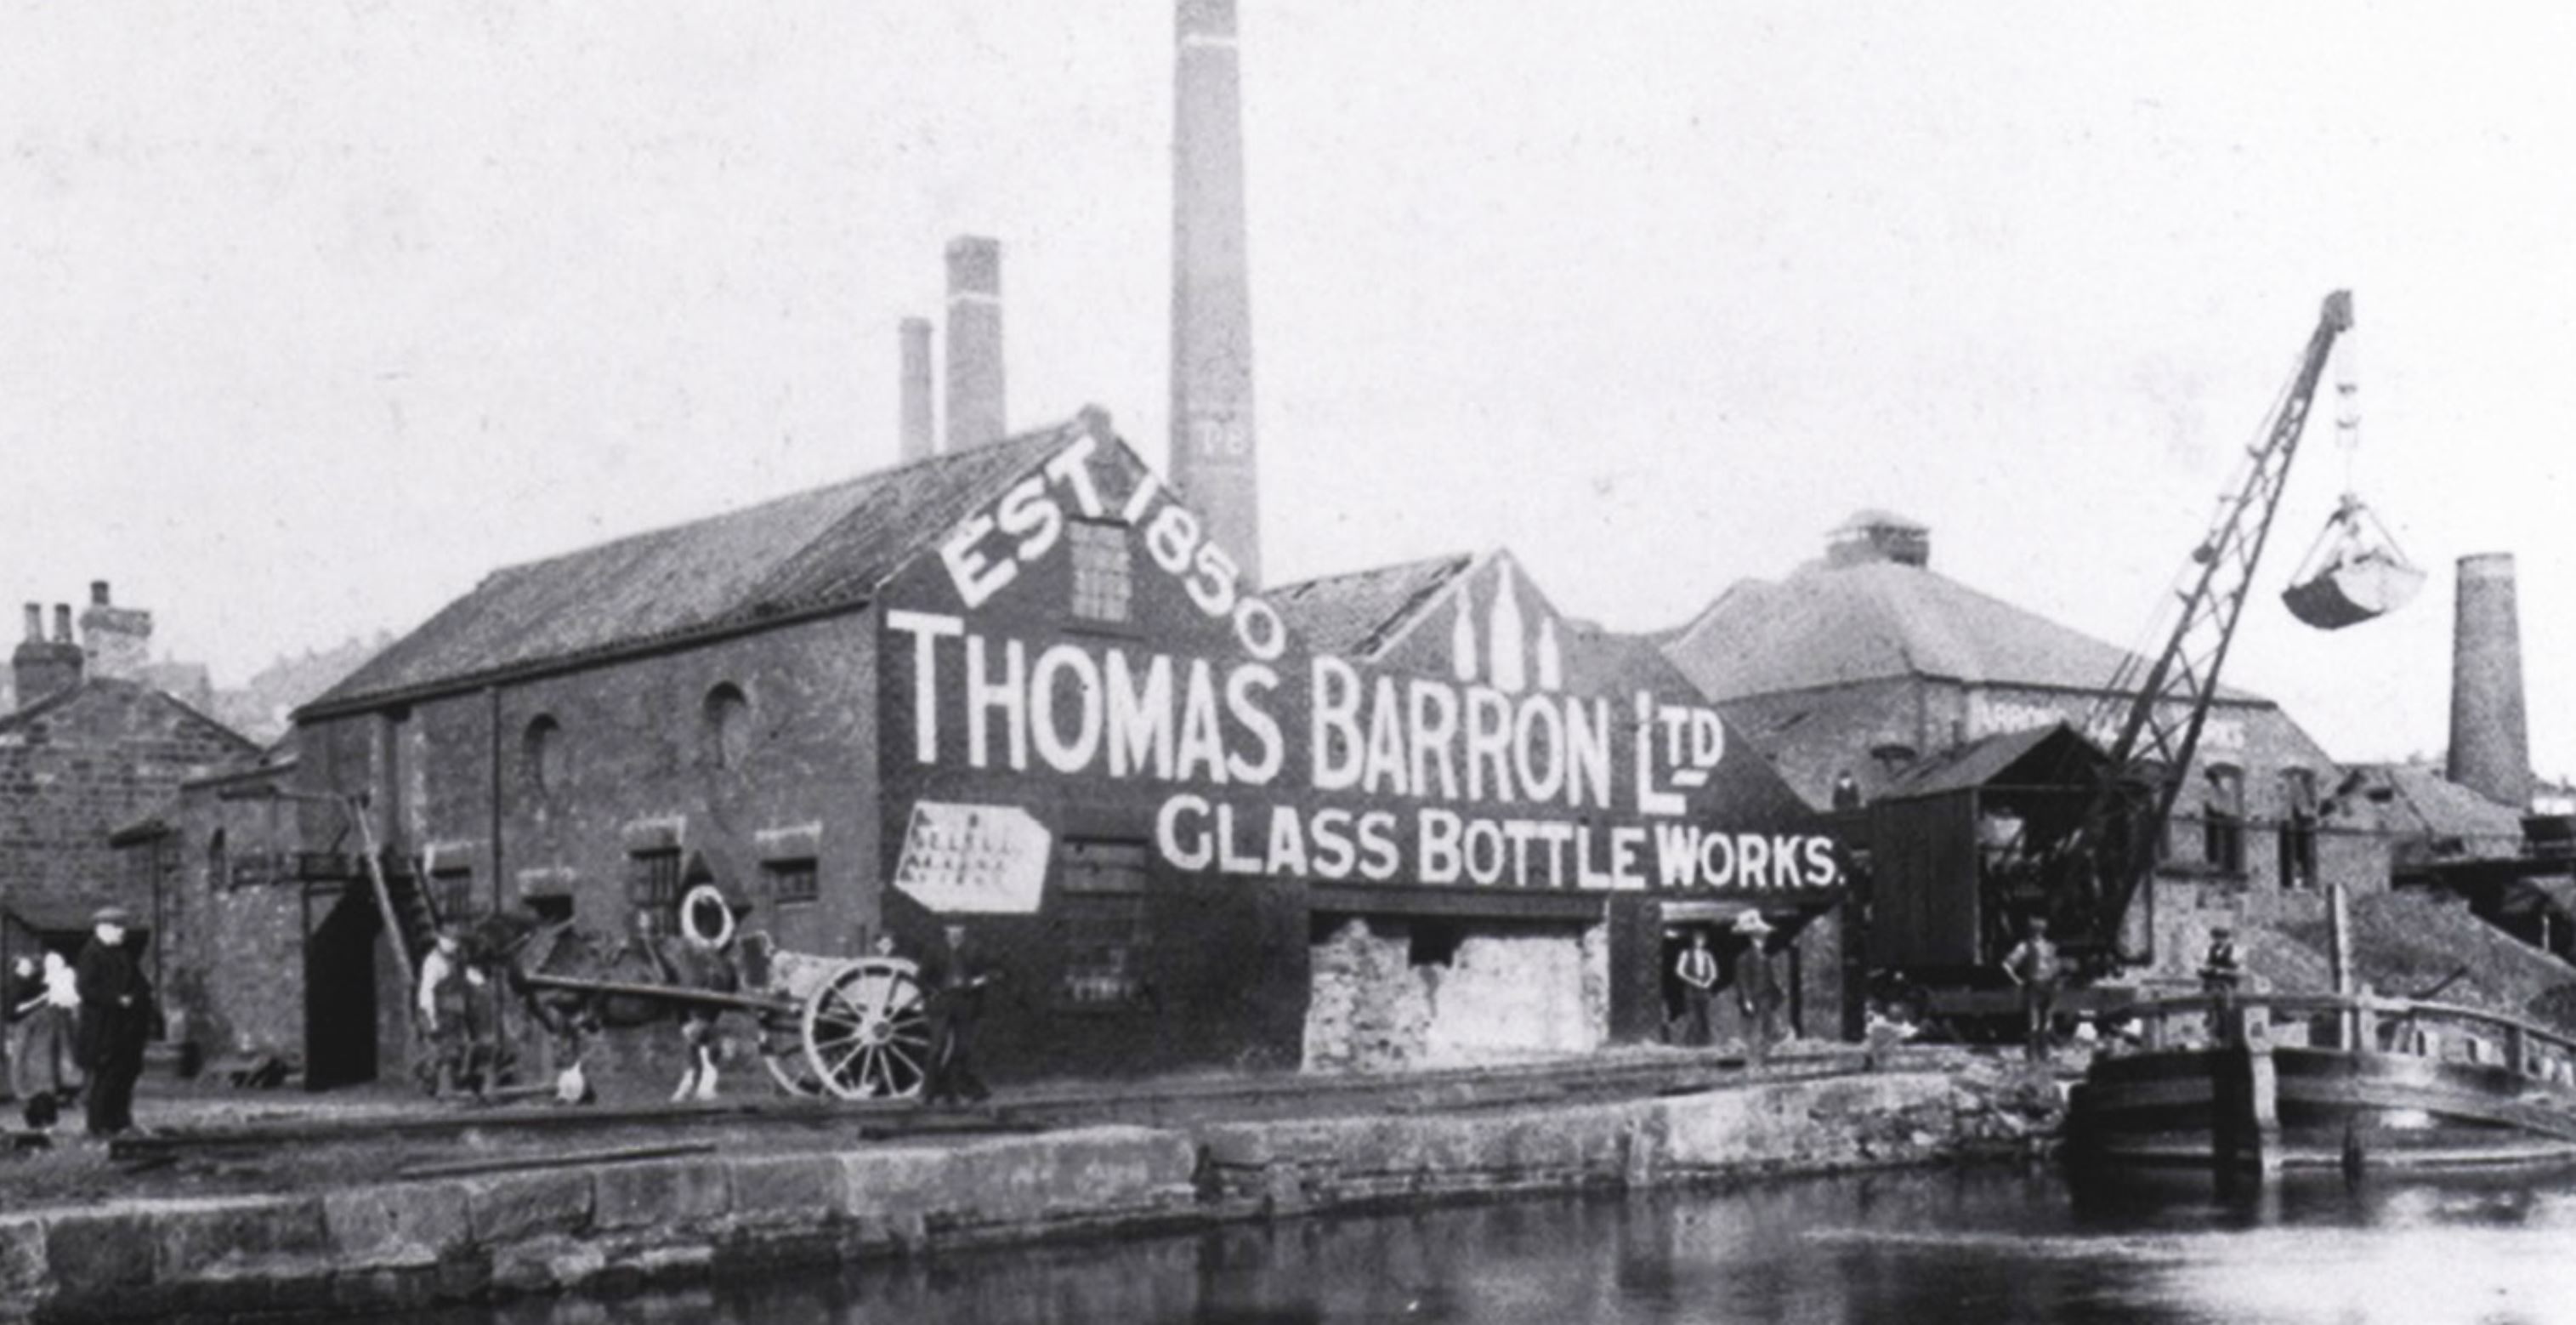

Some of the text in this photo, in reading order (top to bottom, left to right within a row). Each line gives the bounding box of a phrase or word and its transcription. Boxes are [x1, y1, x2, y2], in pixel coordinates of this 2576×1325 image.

[938, 435, 1285, 661] EST 1850
[887, 609, 1285, 785] THOMAS
[1310, 653, 1612, 809] BARRON
[1156, 794, 1847, 890] GLASS BOTTLE WORKS.
